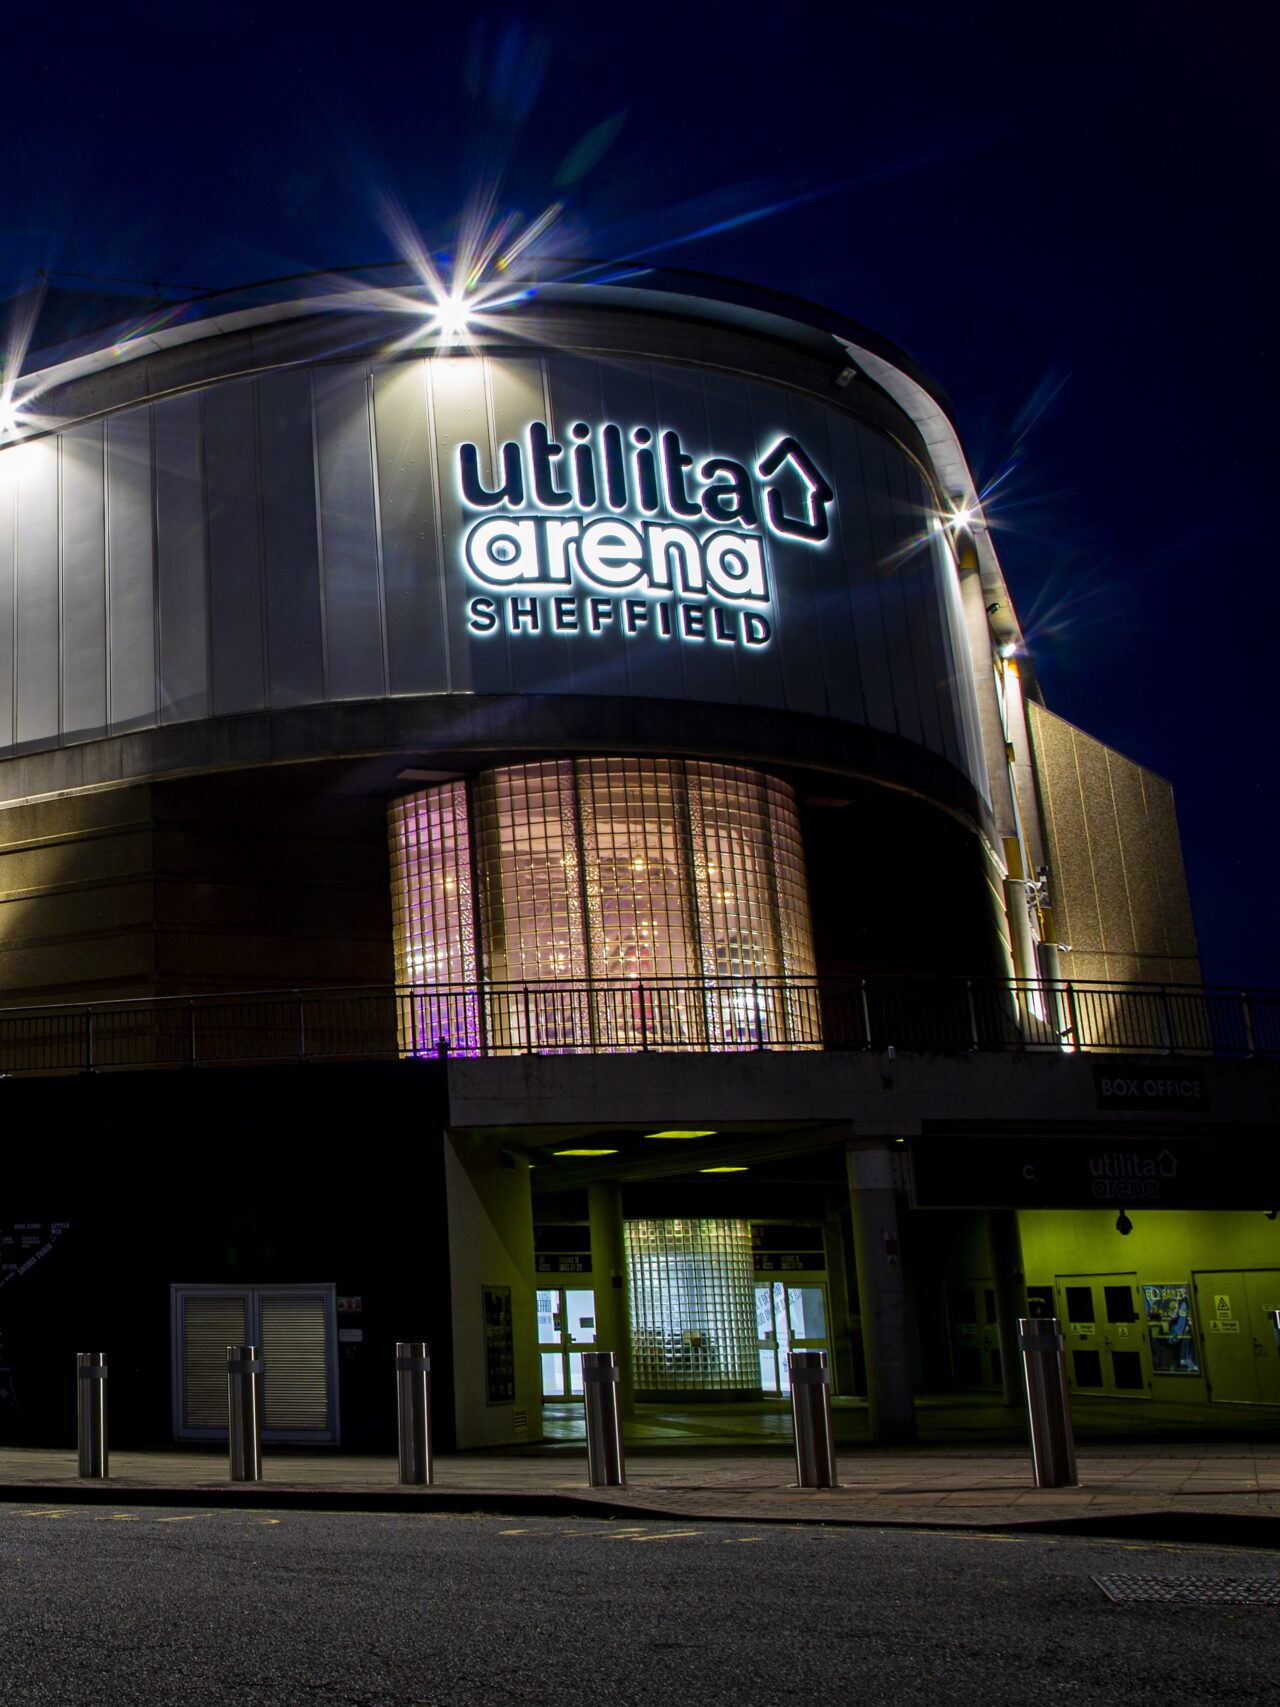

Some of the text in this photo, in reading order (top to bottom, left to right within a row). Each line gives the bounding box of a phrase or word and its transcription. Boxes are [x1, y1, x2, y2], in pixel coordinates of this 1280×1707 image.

[458, 421, 759, 527] utilita
[465, 513, 772, 603] arena
[469, 597, 773, 647] SHEFFIELD
[1101, 1078, 1201, 1098] BOX OFFICE
[1088, 1152, 1157, 1177] utilita
[1092, 1179, 1160, 1199] arena
